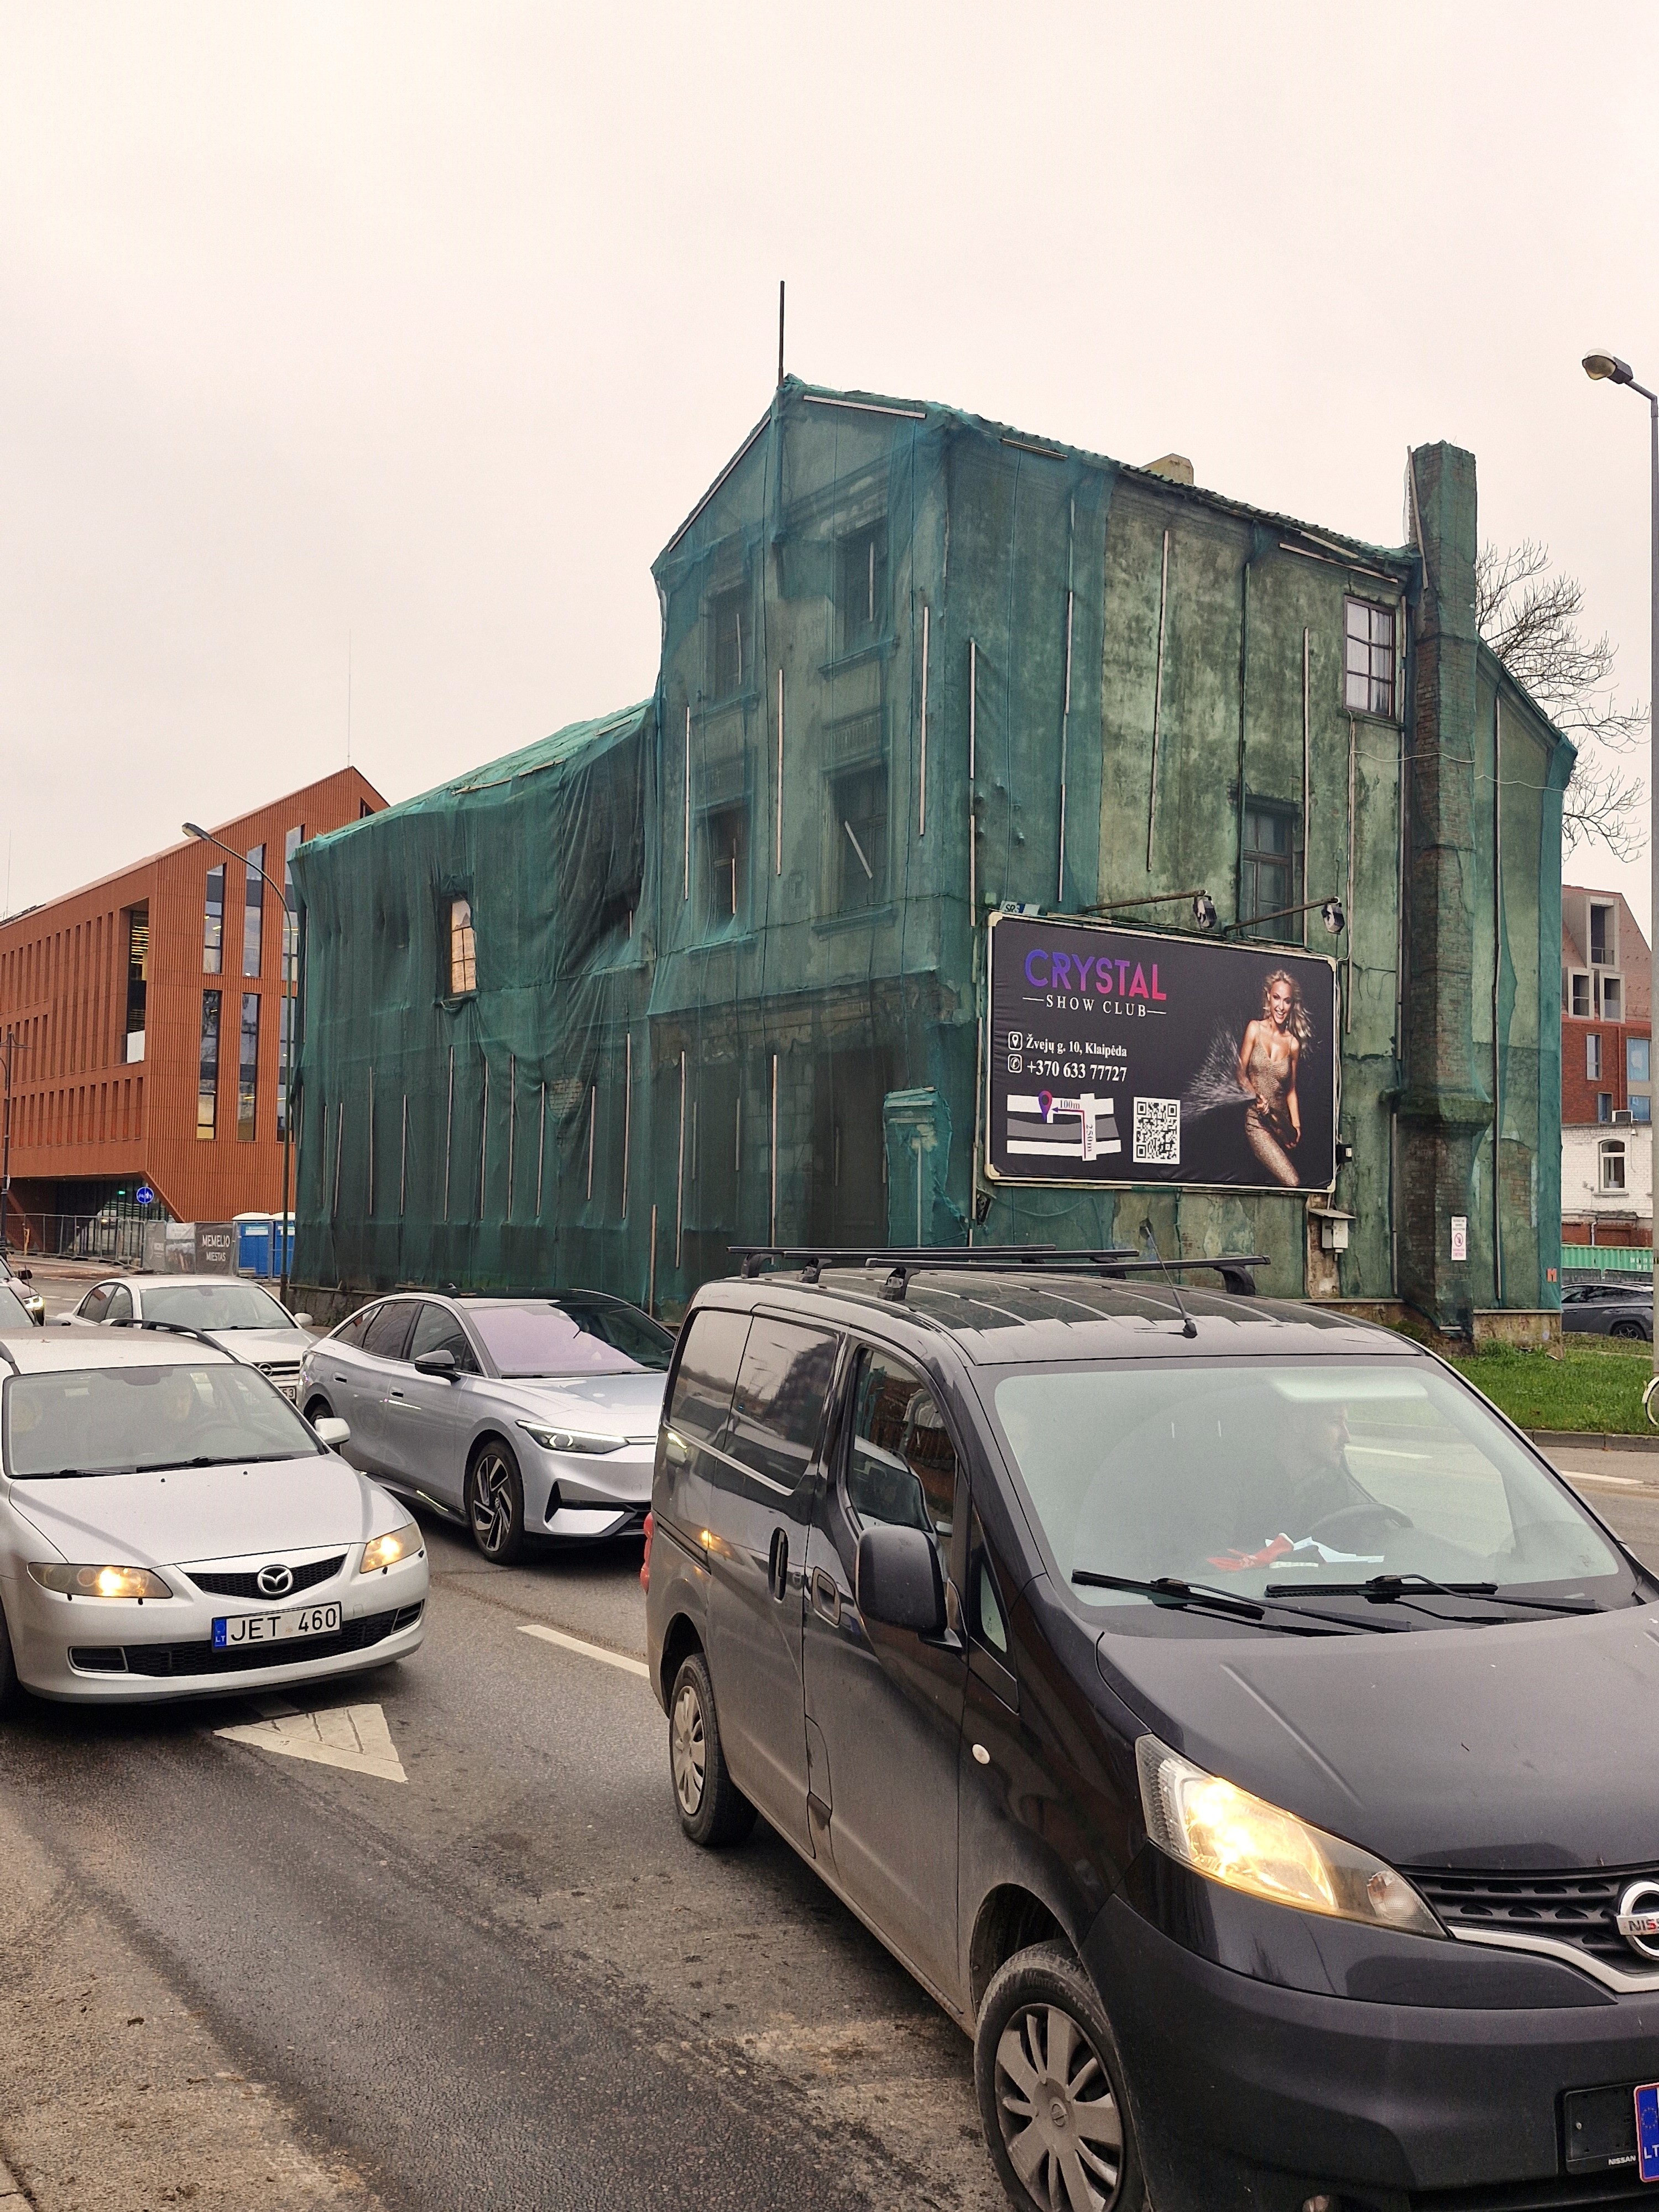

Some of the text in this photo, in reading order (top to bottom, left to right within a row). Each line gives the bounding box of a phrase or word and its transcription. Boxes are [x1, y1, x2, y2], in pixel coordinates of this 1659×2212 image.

[1025, 948, 1166, 1000] CRYSTAL
[1046, 994, 1146, 1017] SHOW CLUB
[1026, 1033, 1127, 1058] Žvejų g. 10, Klaipėda
[1027, 1060, 1127, 1082] +370 633 77727
[1060, 1099, 1080, 1109] 100m
[202, 1234, 231, 1248] MEMELIO
[206, 1251, 226, 1262] MIESTAS
[231, 1608, 336, 1641] JET 460
[1608, 2155, 1636, 2166] NISSAN
